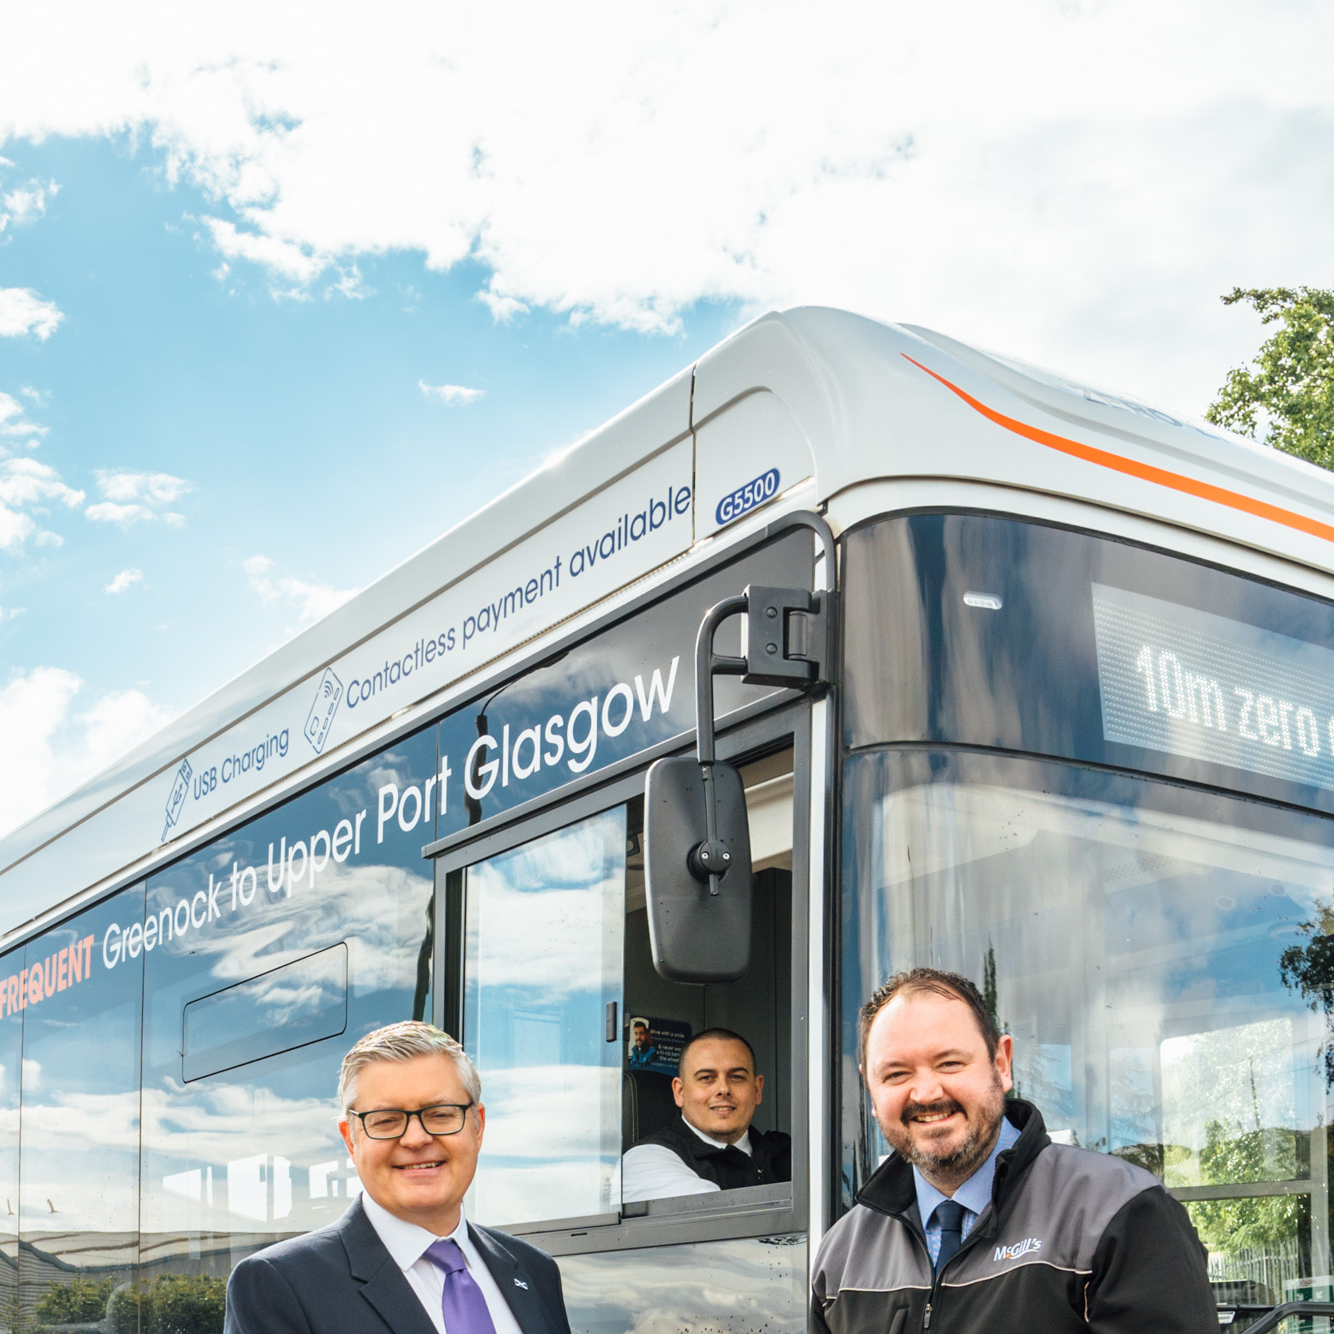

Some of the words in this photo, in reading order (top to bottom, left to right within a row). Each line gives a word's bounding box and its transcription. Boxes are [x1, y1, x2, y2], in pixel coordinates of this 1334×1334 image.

[720, 472, 776, 521] G5500
[346, 627, 456, 708] Contactless
[462, 556, 562, 649] payment
[569, 486, 691, 577] available
[1136, 644, 1227, 731] 10m
[1234, 687, 1320, 757] zero
[193, 767, 217, 800] USB
[221, 728, 289, 783] Charging
[102, 874, 222, 969] Greenock
[230, 861, 257, 911] to
[268, 808, 366, 898] Upper
[377, 755, 452, 844] Port
[464, 656, 680, 800] Glasgow
[993, 1238, 1042, 1261] McGill's
